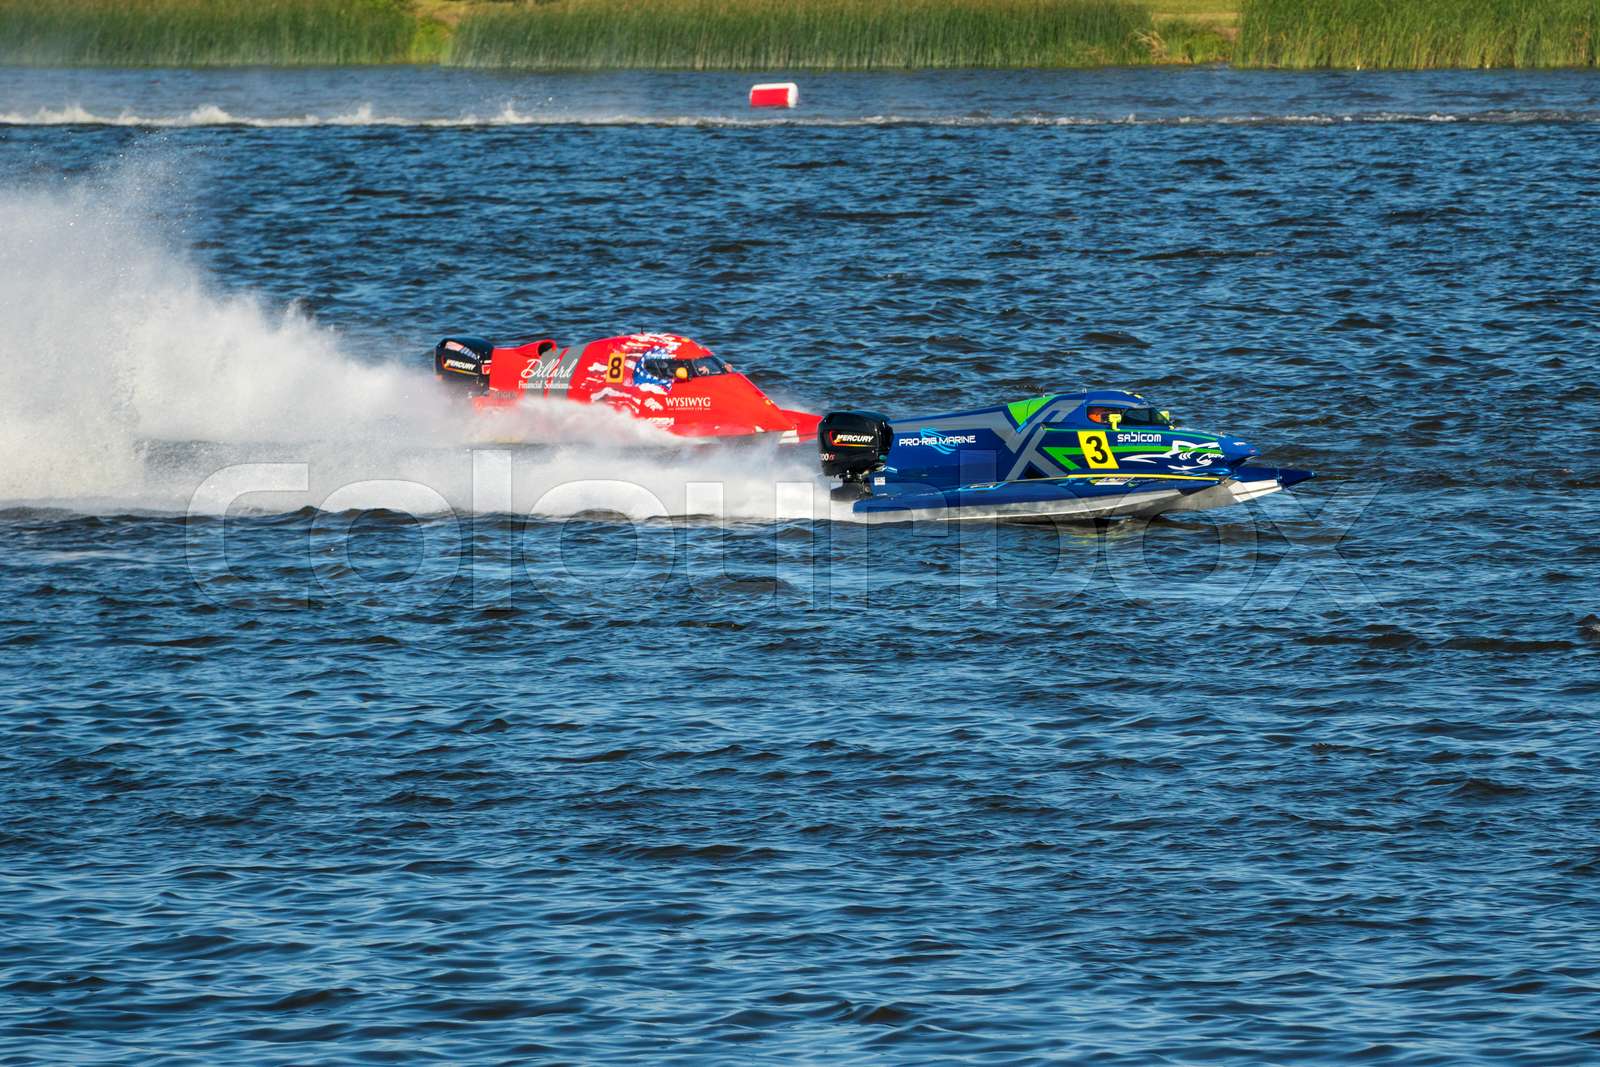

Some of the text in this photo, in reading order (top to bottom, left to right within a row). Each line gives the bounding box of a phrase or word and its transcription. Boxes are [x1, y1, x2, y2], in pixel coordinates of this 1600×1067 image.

[444, 358, 477, 371] MERCURY
[520, 358, 578, 379] Dillard
[608, 356, 623, 379] 8
[665, 396, 712, 408] WYSIWYG
[834, 434, 875, 443] MERCURY
[938, 434, 977, 445] MARINE
[1085, 435, 1109, 465] 3
